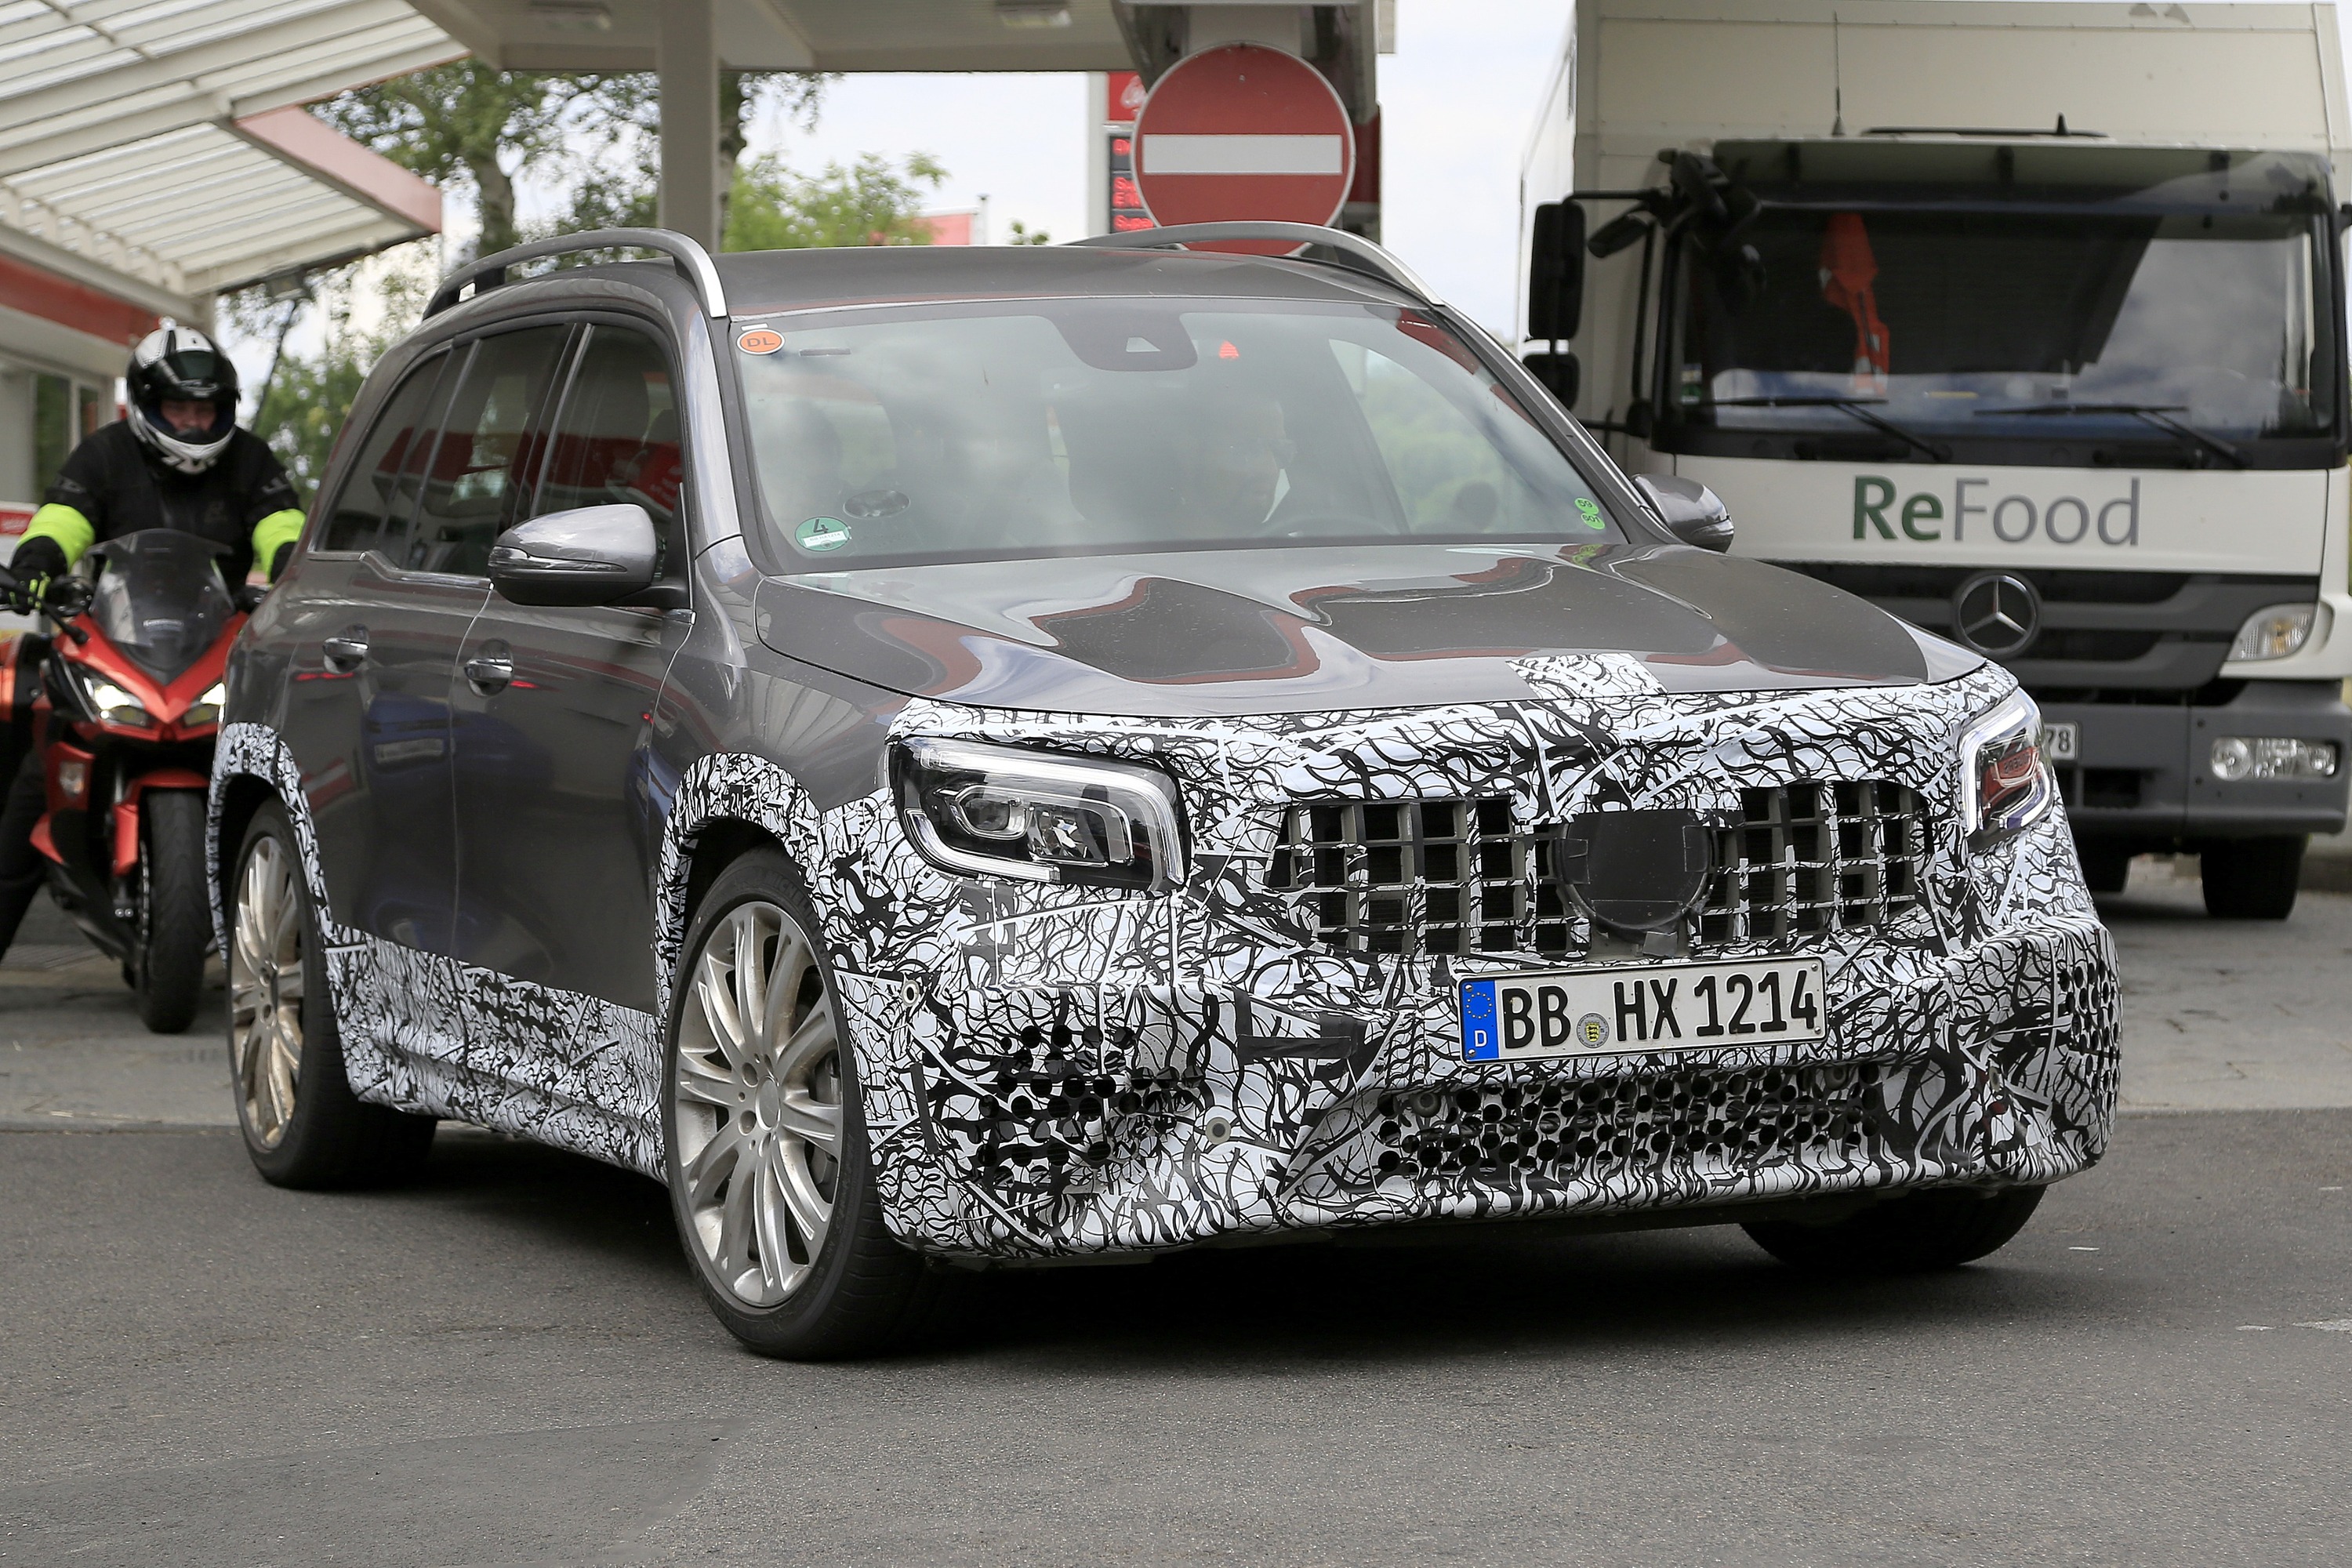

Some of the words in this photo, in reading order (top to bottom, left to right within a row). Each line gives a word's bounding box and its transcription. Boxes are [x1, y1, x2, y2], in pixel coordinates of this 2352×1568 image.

[746, 337, 775, 347] DL
[1853, 475, 2141, 546] ReFood
[813, 518, 829, 533] 4
[1501, 985, 1571, 1049] BB
[1613, 978, 1682, 1042] HX
[1693, 969, 1818, 1036] 1214
[1474, 1029, 1487, 1047] D
